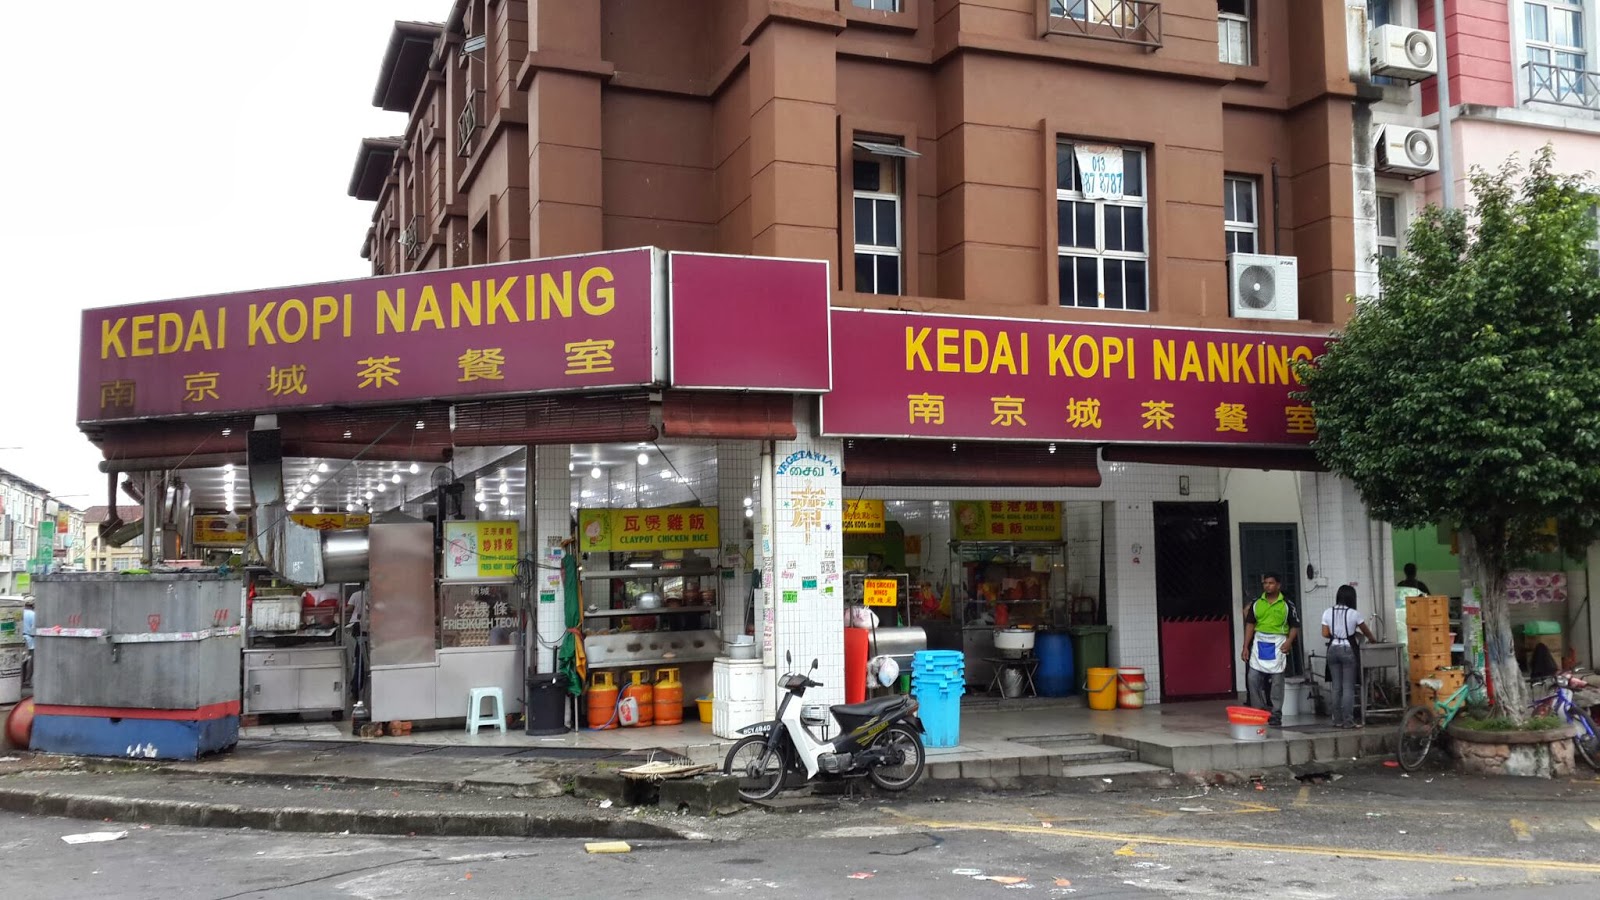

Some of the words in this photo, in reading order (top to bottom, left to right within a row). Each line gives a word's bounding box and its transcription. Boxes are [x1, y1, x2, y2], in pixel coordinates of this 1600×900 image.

[1092, 155, 1106, 172] 013
[1099, 172, 1122, 194] 8787
[101, 307, 227, 359] KEDAI
[249, 294, 353, 347] KOPI
[376, 267, 616, 334] NANKING
[905, 326, 1029, 376] KEDAI
[1048, 333, 1136, 380] KOPI
[1153, 339, 1314, 386] NANKING
[100, 339, 615, 409] 南京城茶餐室
[908, 392, 1316, 434] 南京城茶餐室
[776, 449, 840, 476] VEGETARIAN
[620, 535, 654, 544] CLAYPOT
[658, 534, 689, 543] CHICKEN
[692, 533, 709, 542] RICE
[442, 619, 468, 629] FRIED
[494, 616, 520, 628] TEOW
